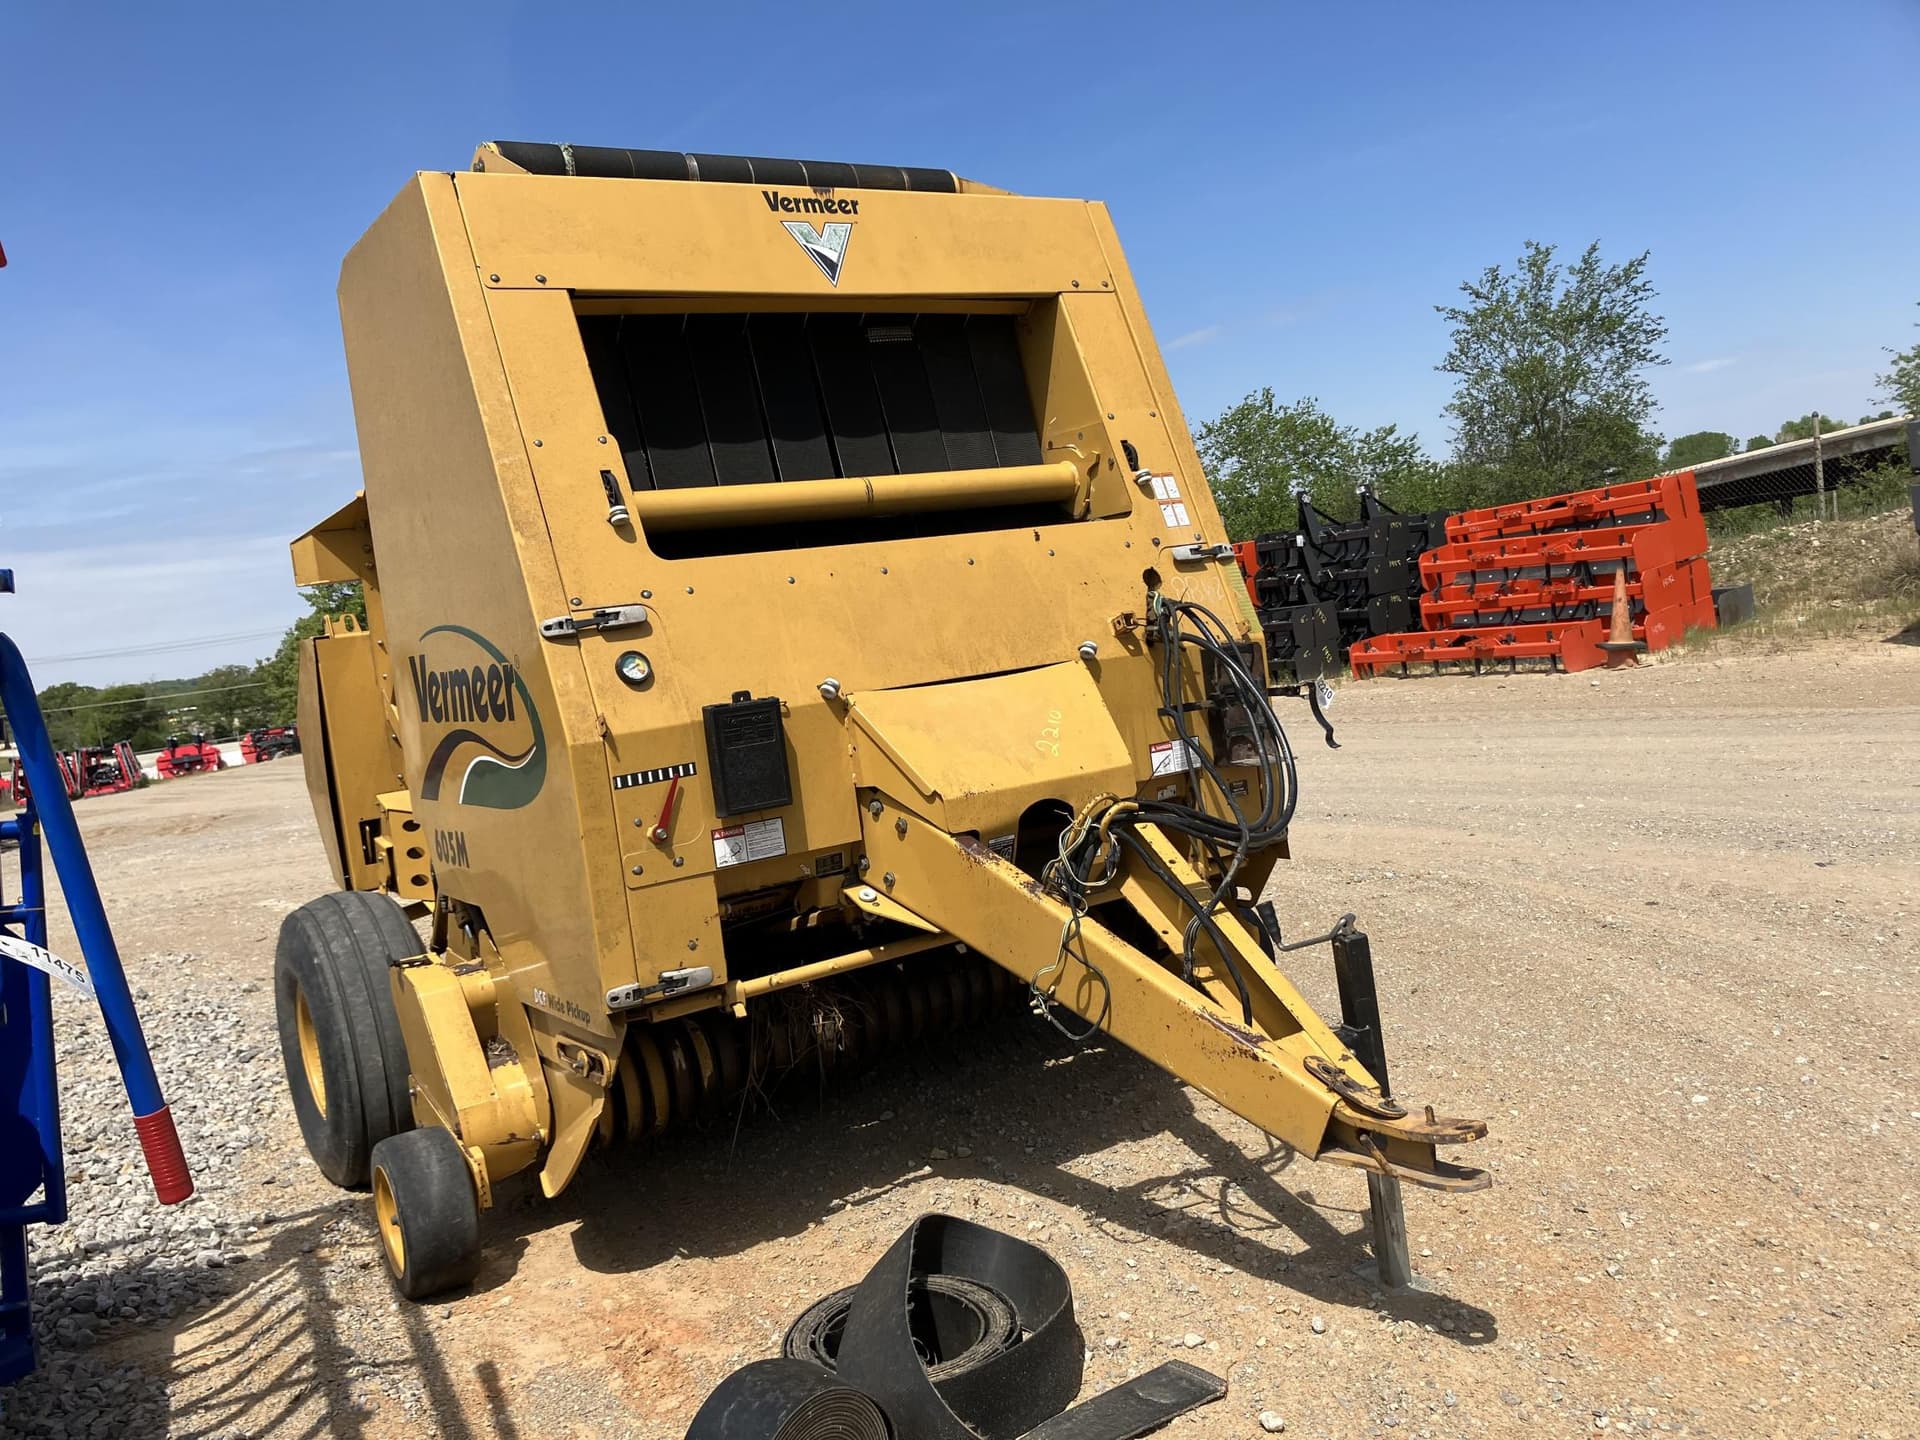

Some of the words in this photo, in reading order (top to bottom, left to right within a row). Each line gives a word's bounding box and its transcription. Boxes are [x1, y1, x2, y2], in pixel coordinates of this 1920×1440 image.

[761, 190, 859, 215] Vermeer
[408, 654, 516, 723] Vermeer
[1035, 710, 1062, 758] 2210
[435, 828, 470, 869] 605M
[31, 946, 86, 984] 11475
[547, 992, 565, 1014] Wide
[566, 1000, 591, 1027] Pickup
